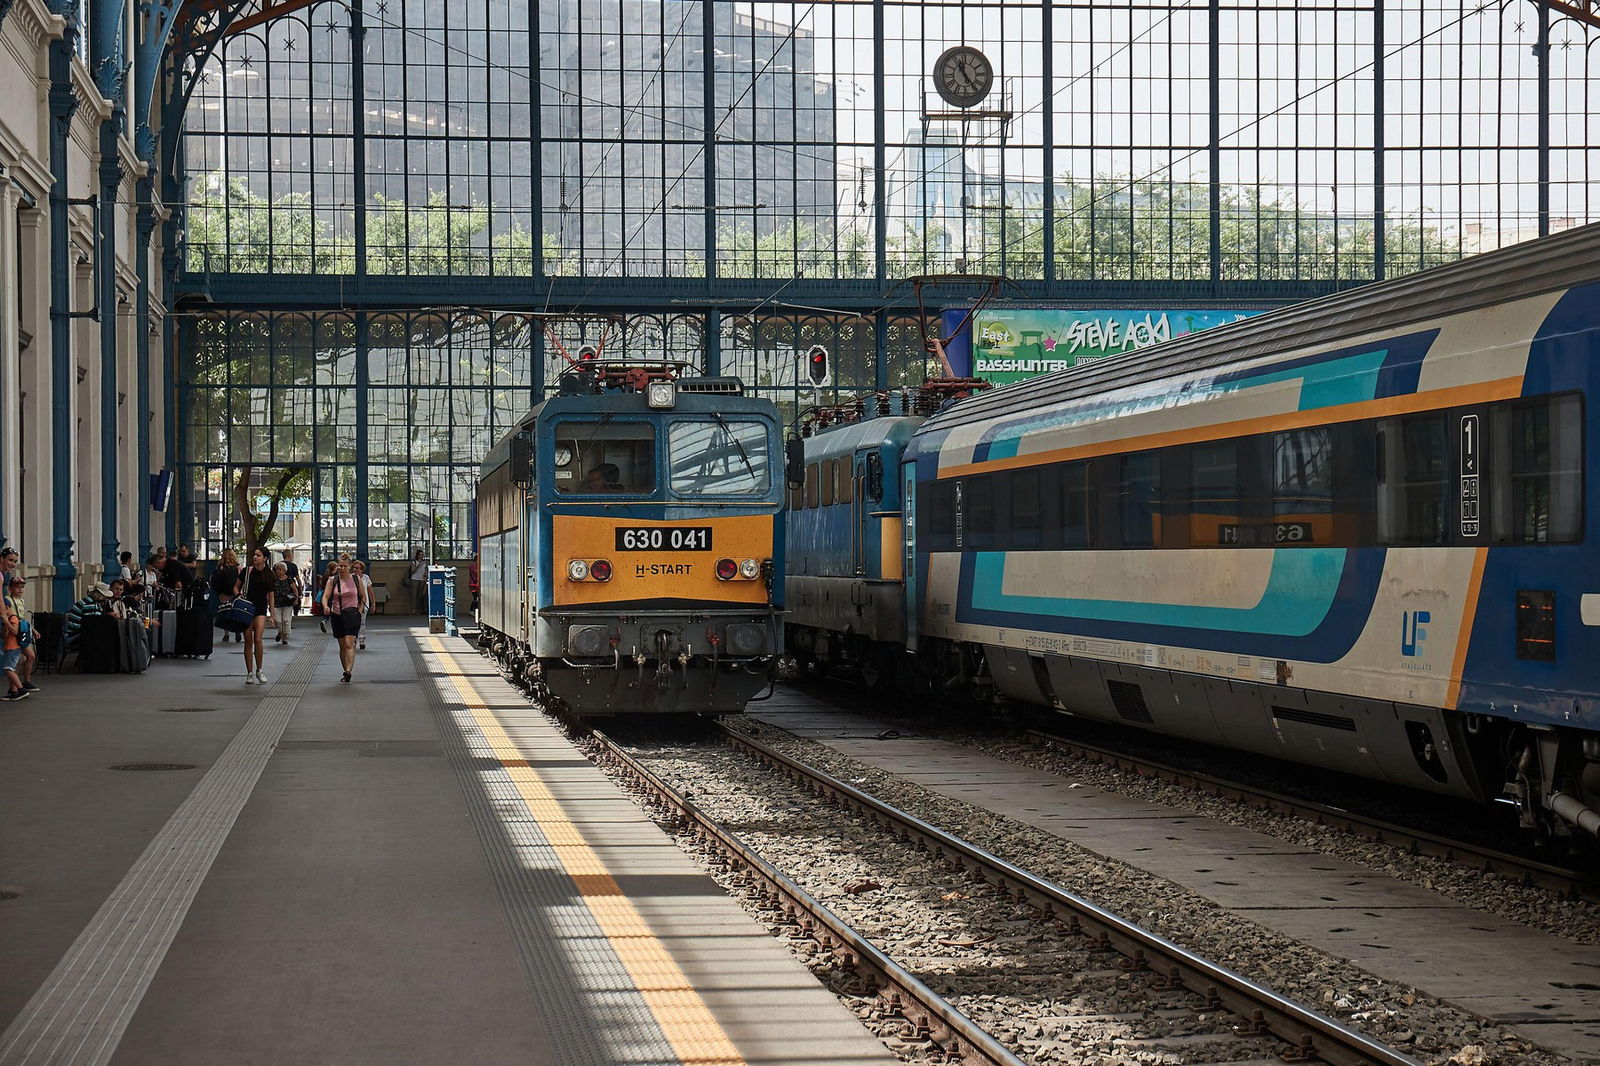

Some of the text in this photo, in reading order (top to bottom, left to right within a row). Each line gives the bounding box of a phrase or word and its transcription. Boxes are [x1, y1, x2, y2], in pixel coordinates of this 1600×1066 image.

[982, 327, 1010, 342] East
[1066, 312, 1171, 354] STEVE AOKI
[976, 359, 1068, 372] BASSHUNTER
[1464, 420, 1472, 455] 1
[320, 518, 397, 528] STARUCKS
[623, 529, 707, 549] 630 041
[635, 563, 693, 577] H-START
